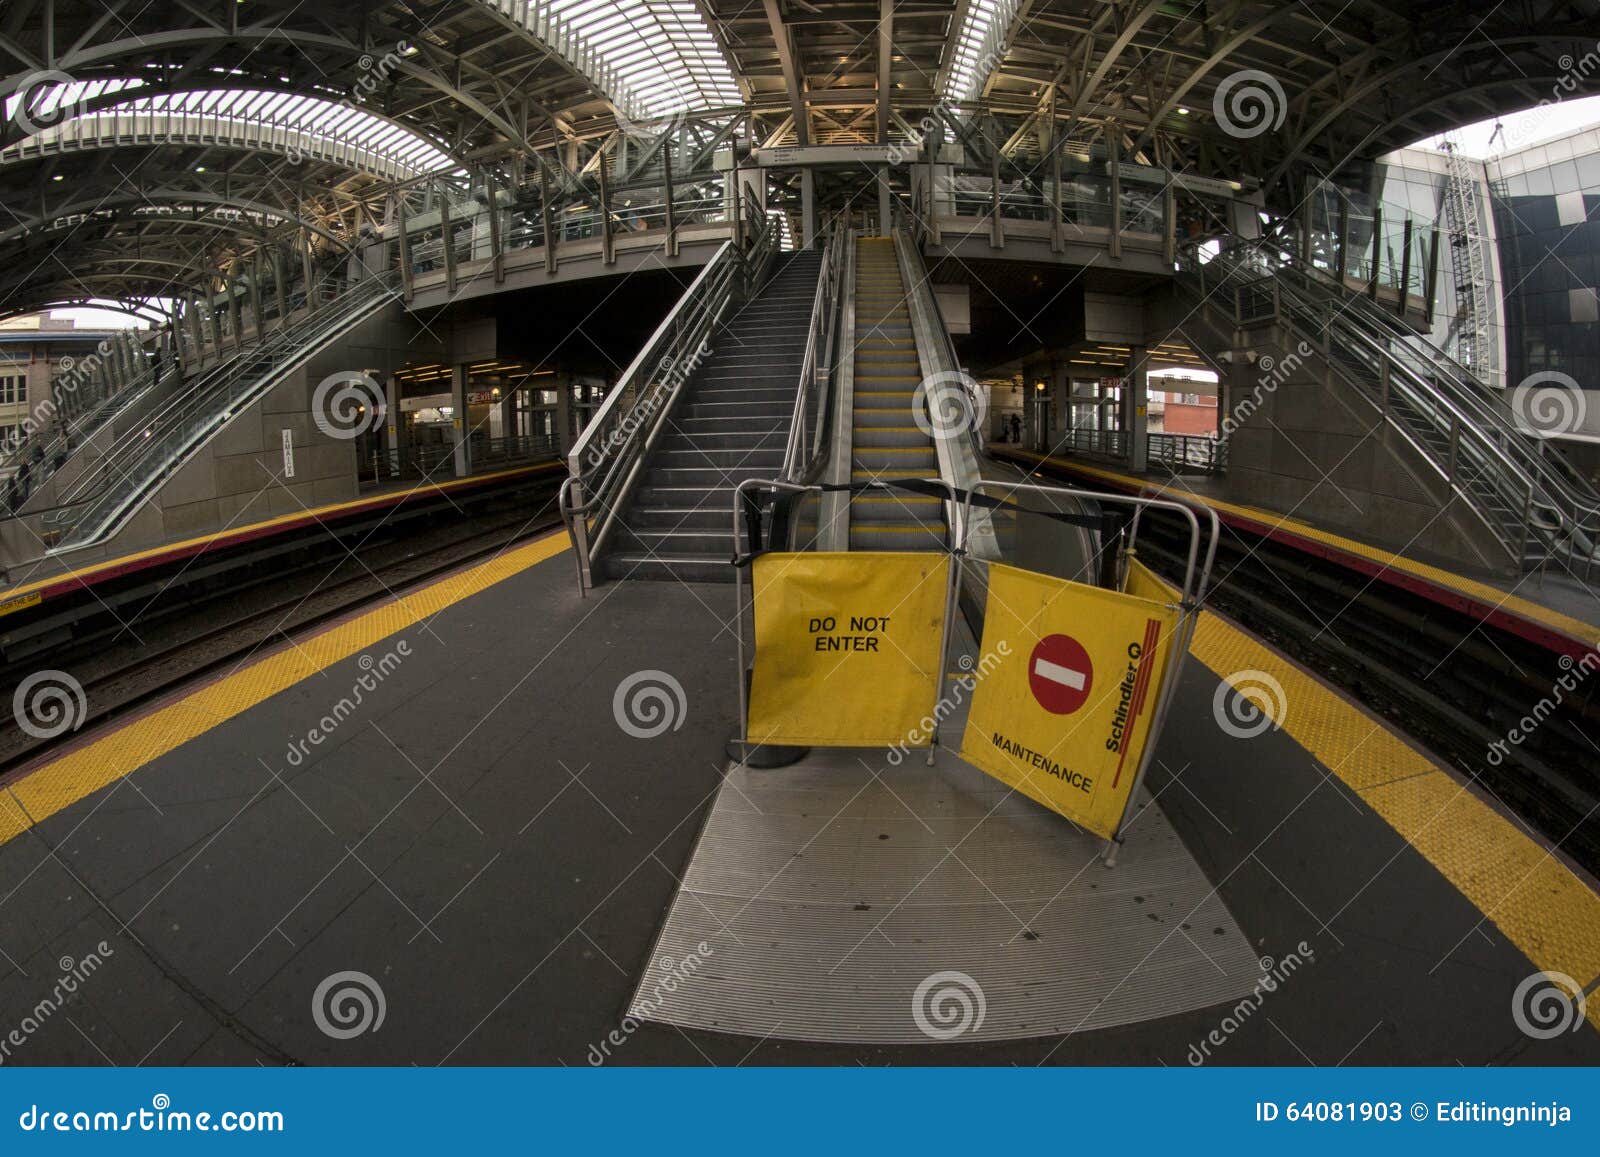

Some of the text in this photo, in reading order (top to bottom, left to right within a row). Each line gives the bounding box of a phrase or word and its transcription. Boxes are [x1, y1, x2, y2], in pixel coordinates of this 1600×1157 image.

[809, 617, 890, 633] DO NOT
[815, 636, 878, 652] ENTER
[1106, 662, 1138, 752] Schindler
[992, 732, 1093, 793] MAINTENANCE
